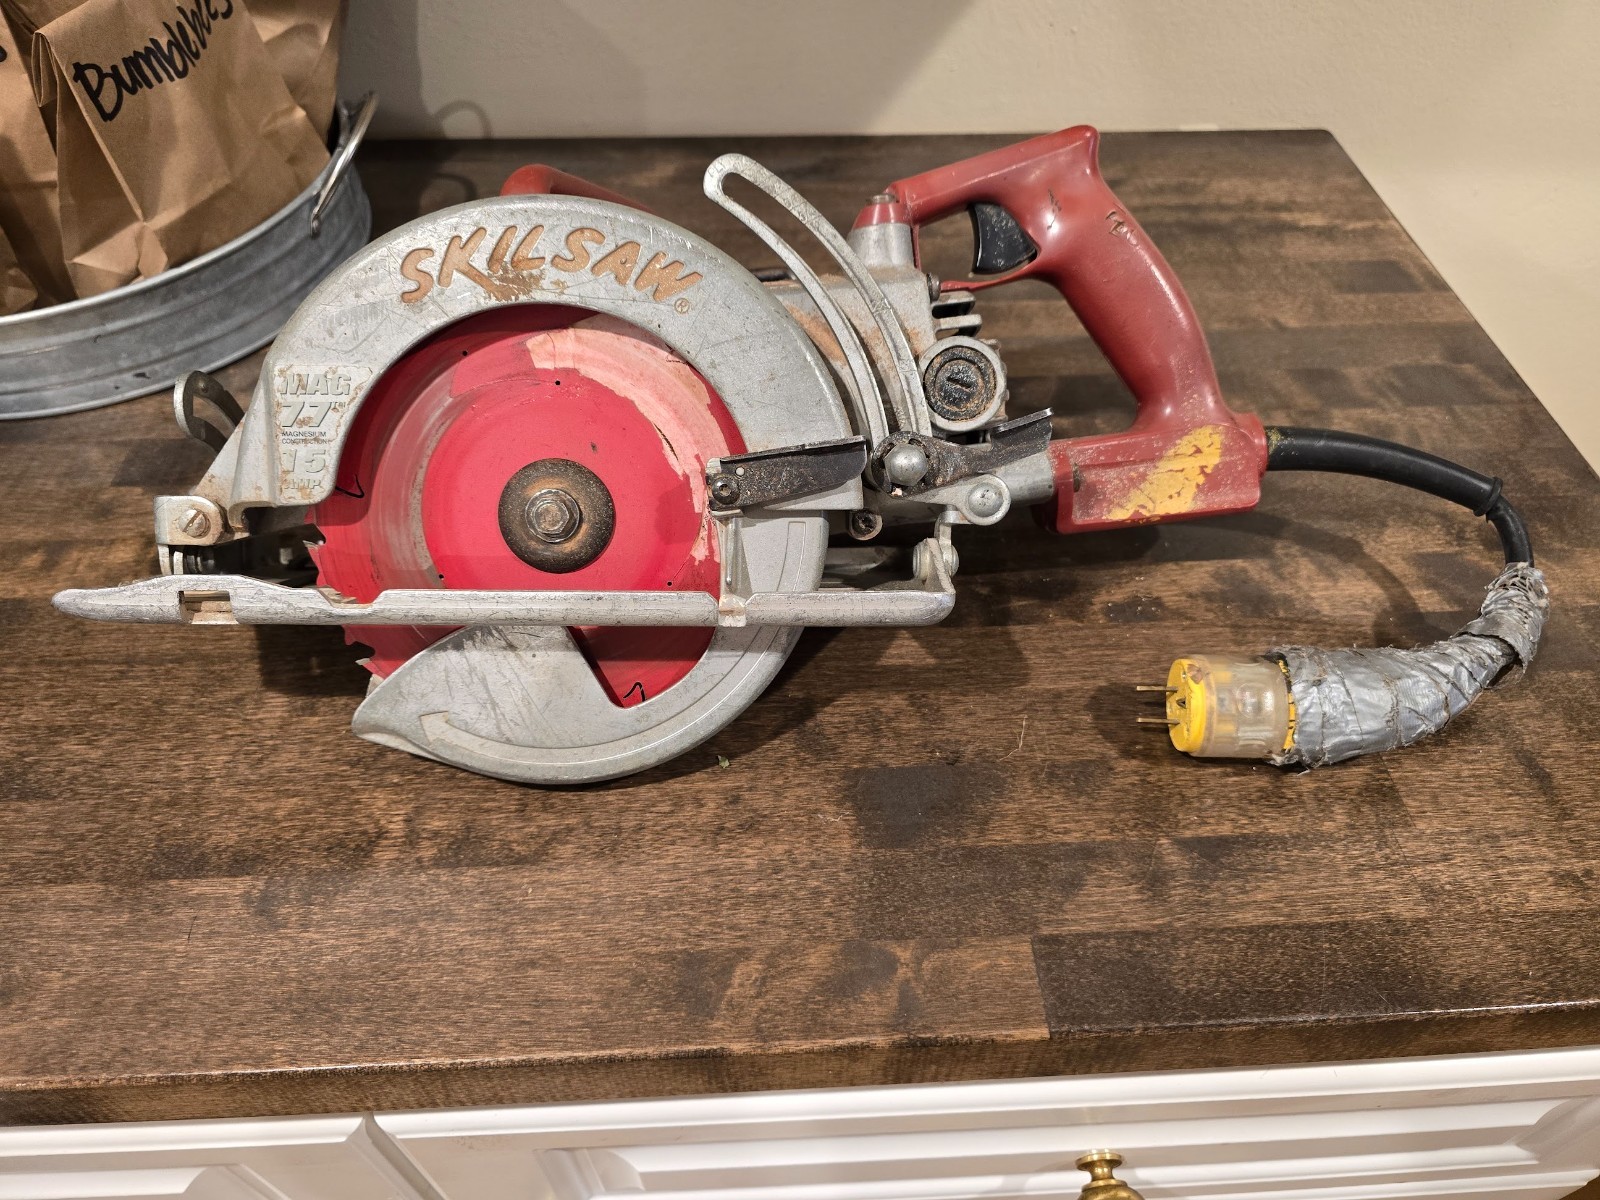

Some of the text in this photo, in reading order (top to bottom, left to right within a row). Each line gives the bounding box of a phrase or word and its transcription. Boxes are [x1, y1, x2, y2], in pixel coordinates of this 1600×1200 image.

[400, 225, 704, 303] SKILSAW
[280, 373, 351, 395] MAG
[281, 401, 332, 427] 77
[281, 449, 326, 473] 15
